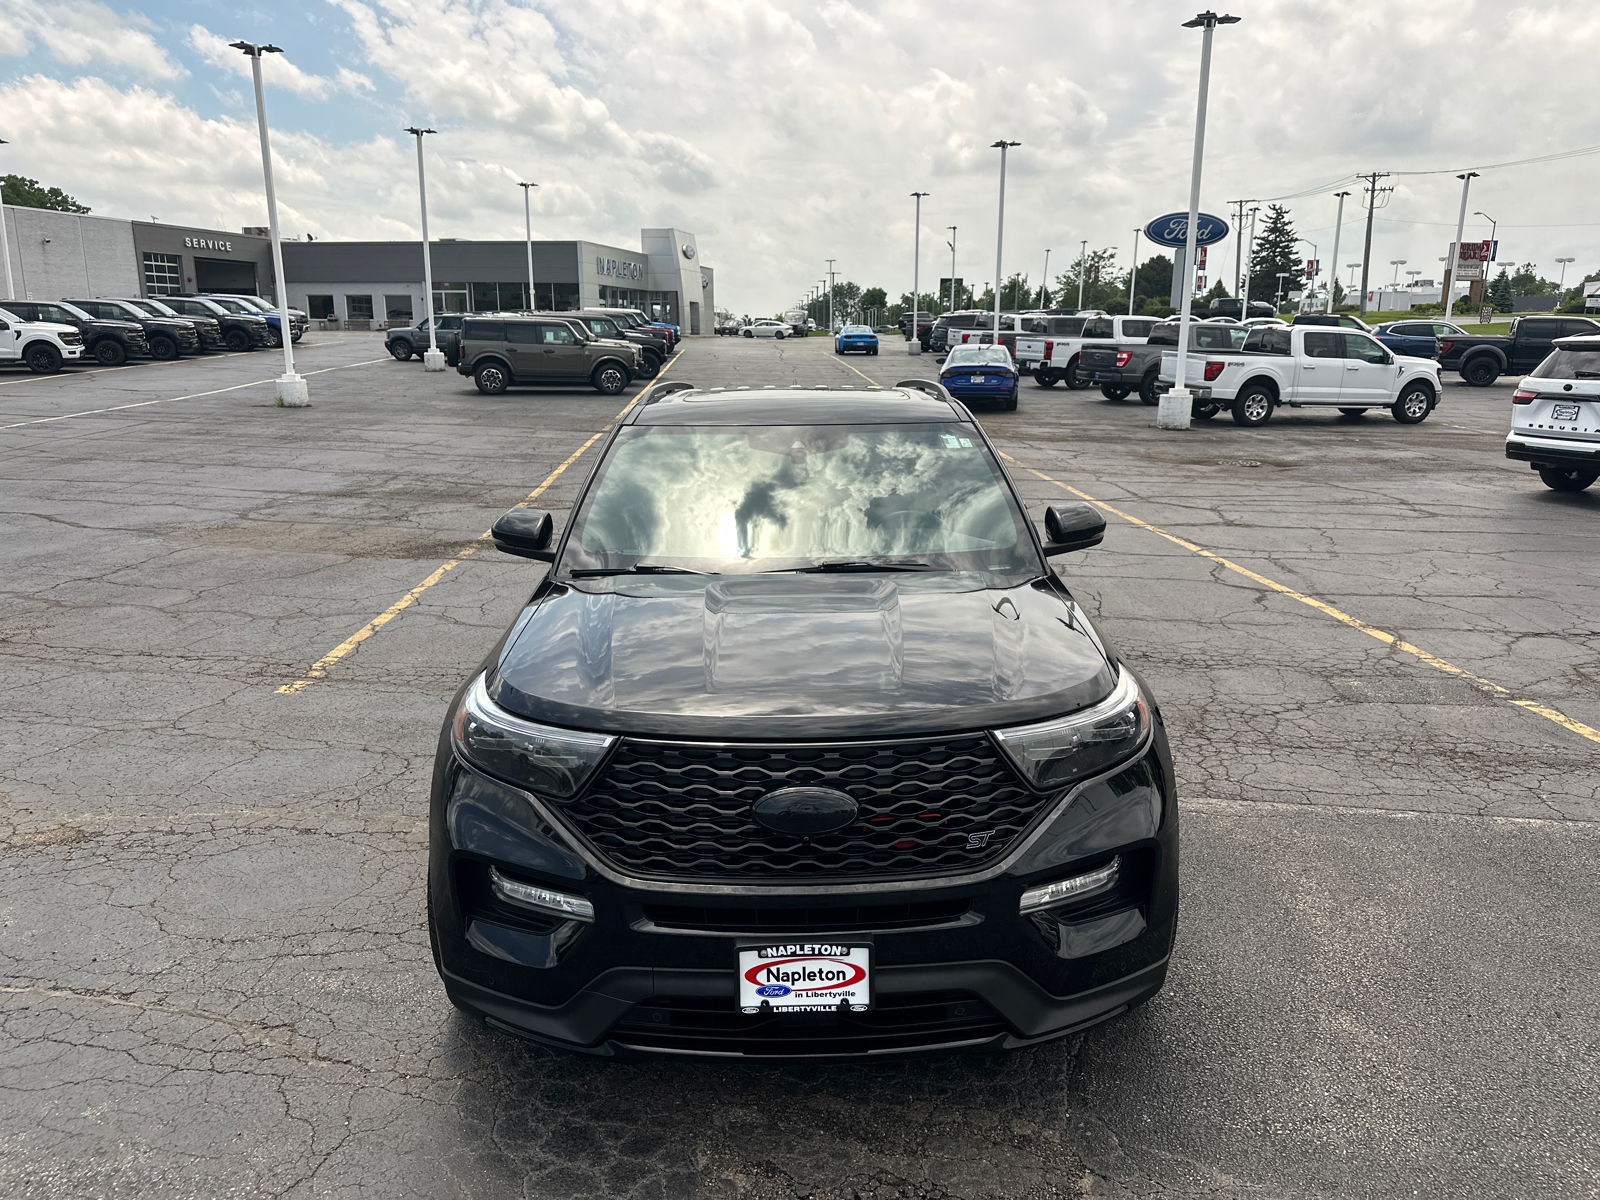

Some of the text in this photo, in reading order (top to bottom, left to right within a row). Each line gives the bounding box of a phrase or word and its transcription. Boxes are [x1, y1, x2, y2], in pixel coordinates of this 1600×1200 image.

[1164, 218, 1213, 239] Fod
[185, 237, 232, 251] SERVICE
[597, 257, 643, 280] NAPLETON
[966, 830, 995, 849] ST
[767, 945, 841, 957] NAPLETON
[766, 967, 846, 986] Napleton
[763, 986, 784, 996] Ford
[806, 991, 856, 999] Libertyville
